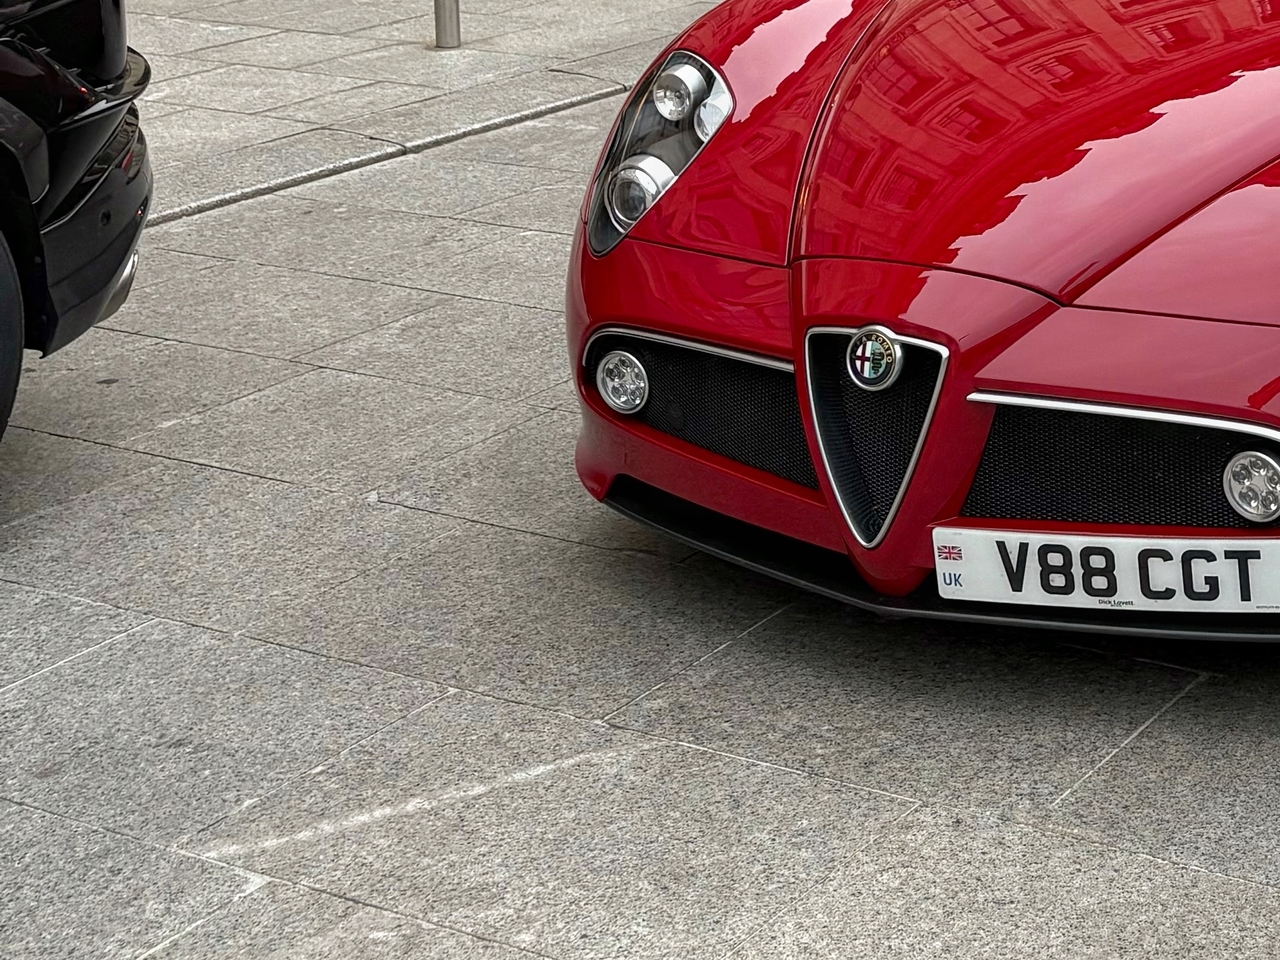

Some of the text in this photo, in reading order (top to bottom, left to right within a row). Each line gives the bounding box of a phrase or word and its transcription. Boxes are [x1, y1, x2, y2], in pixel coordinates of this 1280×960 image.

[871, 334, 893, 363] ROMEO
[943, 572, 964, 588] UK
[995, 540, 1261, 602] V88 CGT
